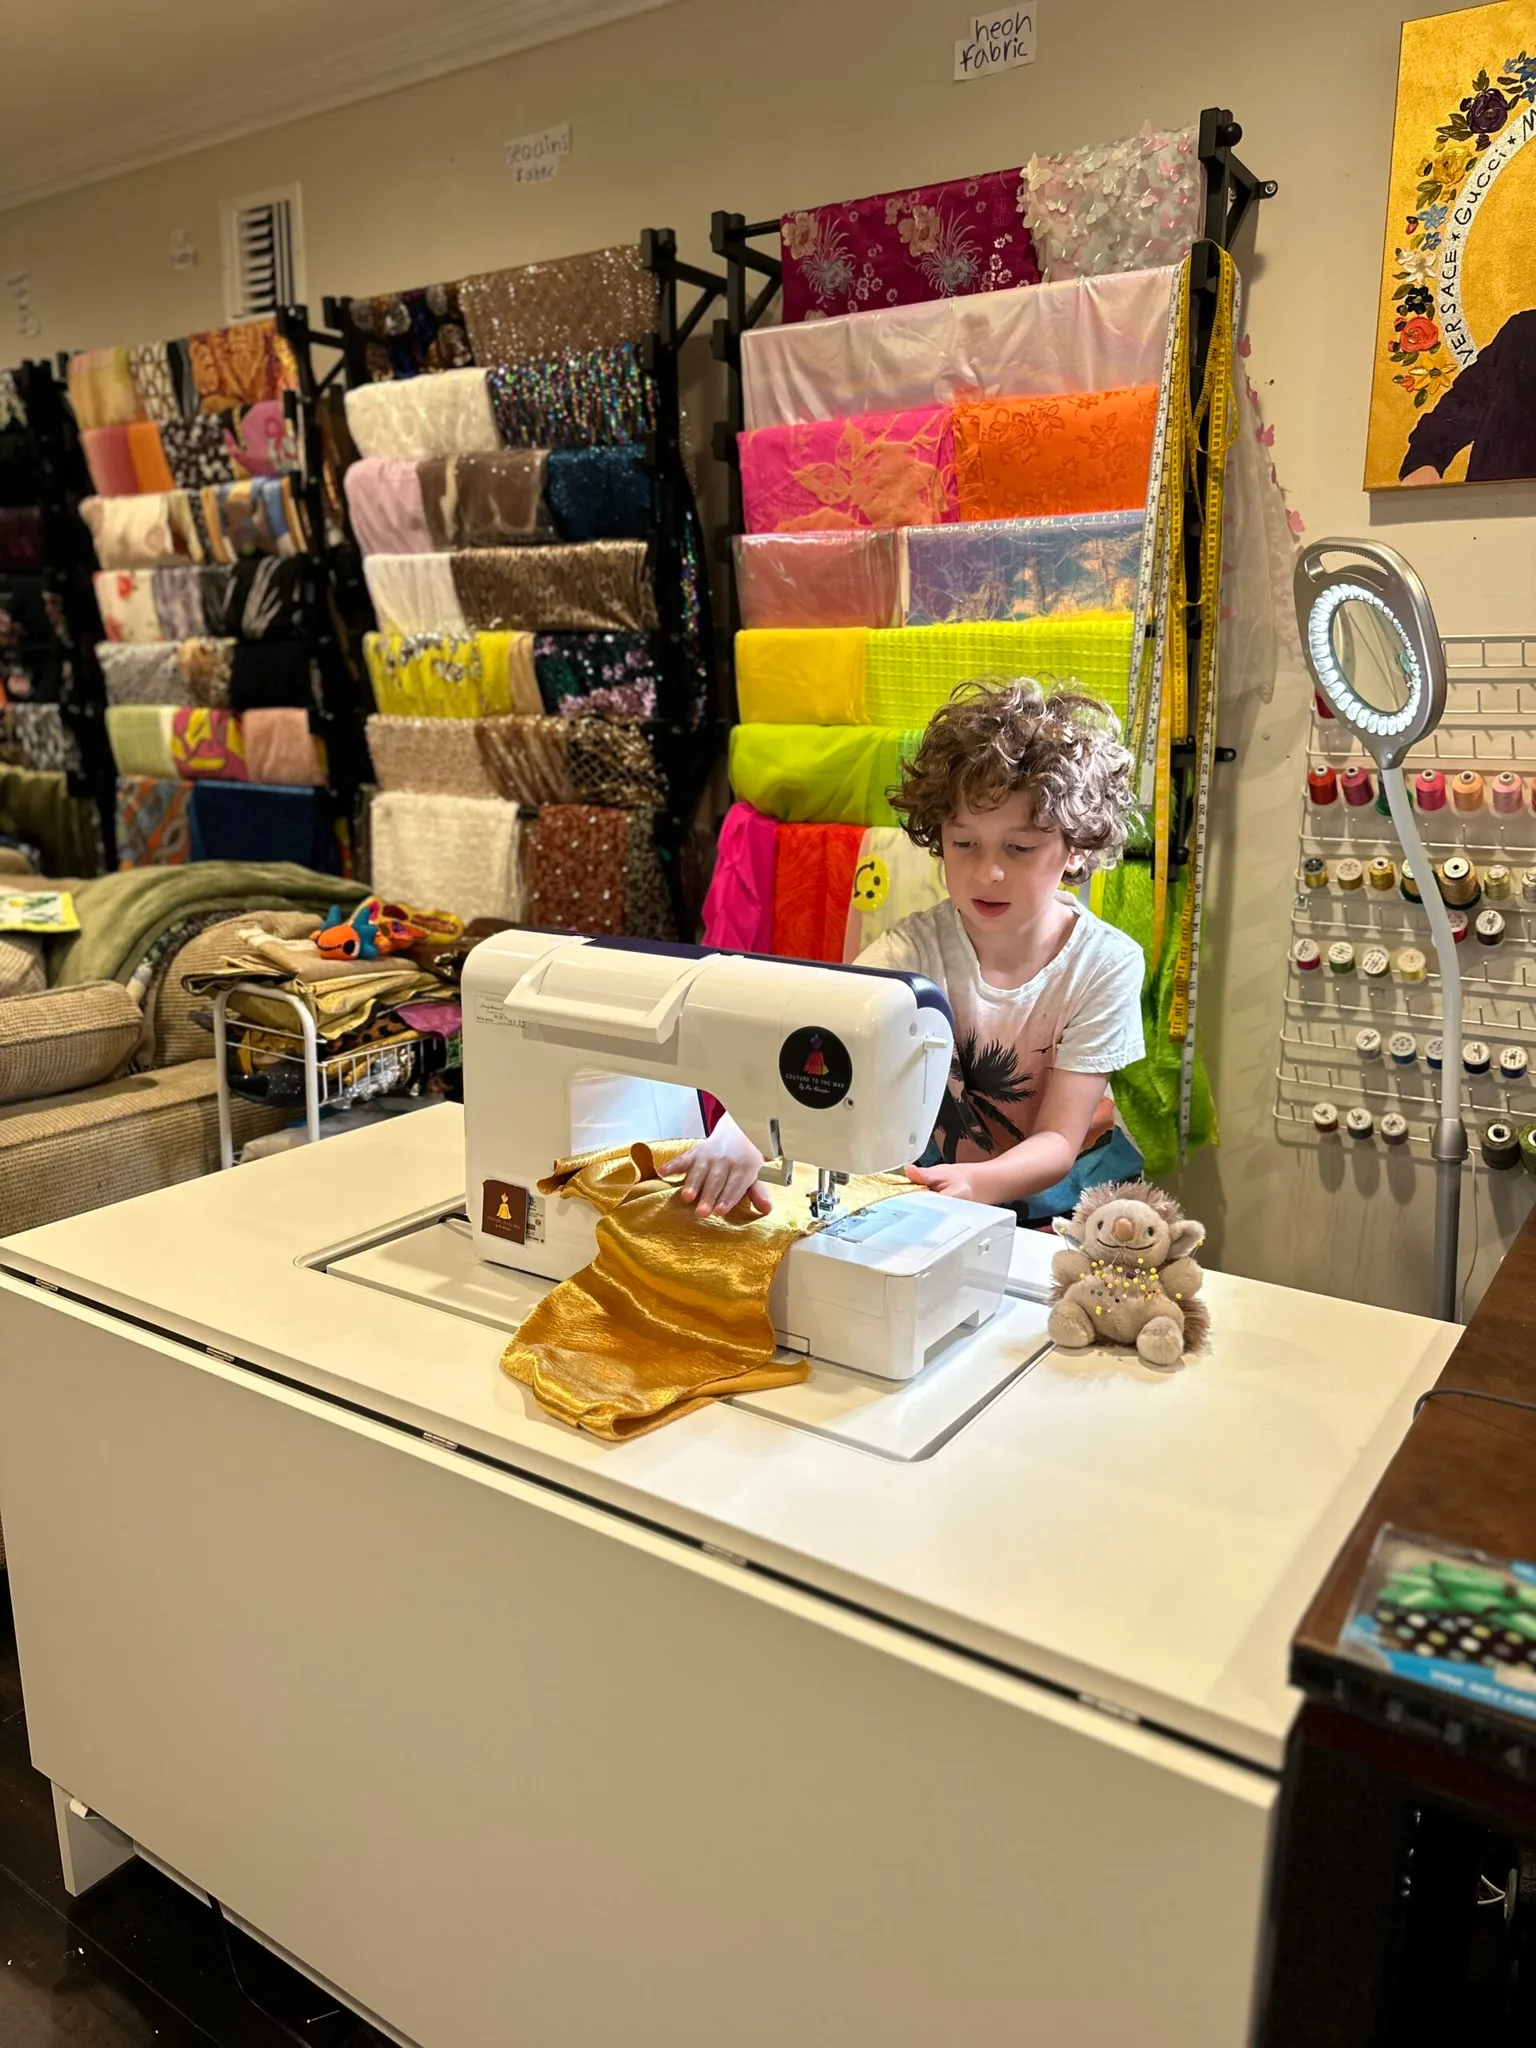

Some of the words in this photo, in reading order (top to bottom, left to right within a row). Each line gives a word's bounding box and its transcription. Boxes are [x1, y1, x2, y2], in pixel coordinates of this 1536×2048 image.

[975, 12, 1032, 43] neon
[960, 37, 1028, 72] fabric
[1454, 149, 1507, 225] Gucci
[1440, 250, 1474, 365] VERSACE
[1202, 763, 1208, 775] 22
[1200, 785, 1206, 795] 21
[1199, 804, 1205, 815] 20
[1198, 824, 1204, 834] 19
[1197, 844, 1203, 854] 18
[1195, 864, 1202, 874] 17
[1194, 884, 1201, 893] 16
[1193, 903, 1200, 913] 15
[1192, 923, 1199, 932] 14
[1191, 942, 1198, 951] 13
[1190, 961, 1197, 970] 12
[1188, 981, 1196, 990] 11
[1188, 1000, 1196, 1009] 10
[785, 1073, 809, 1082] COUTURE
